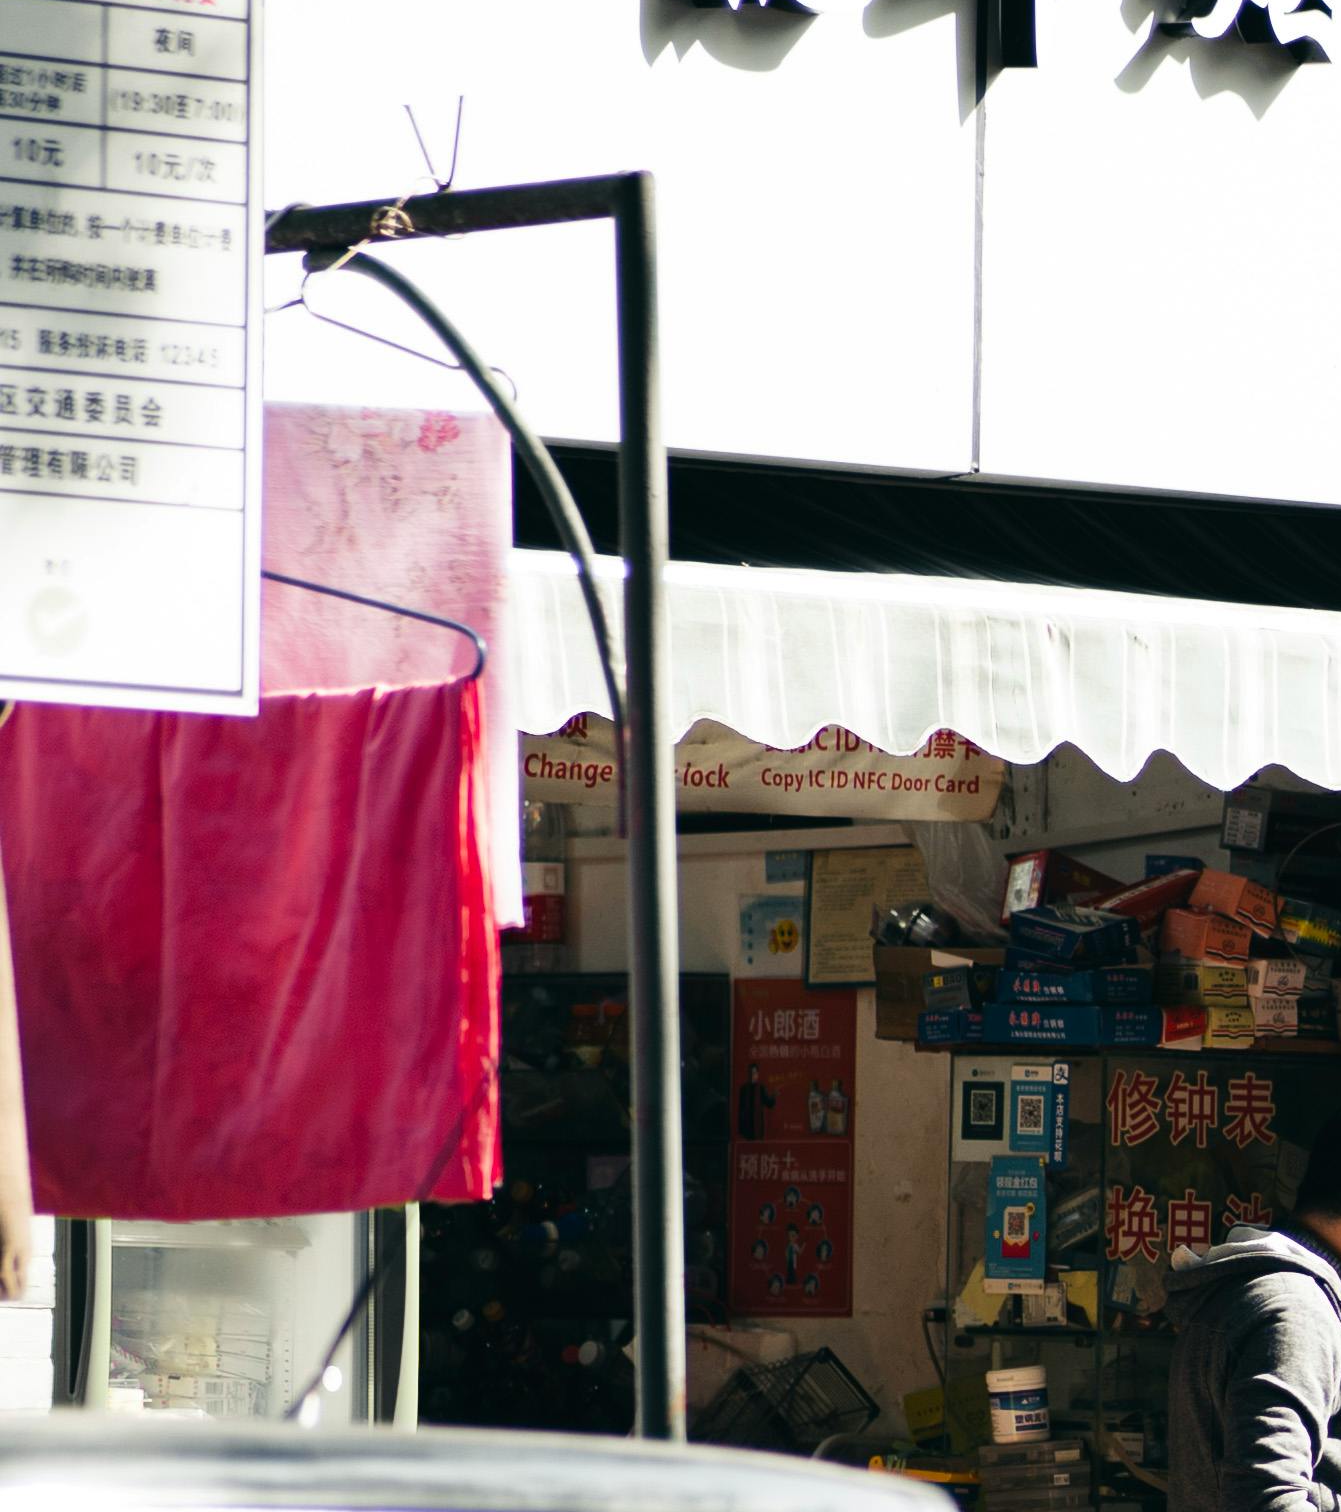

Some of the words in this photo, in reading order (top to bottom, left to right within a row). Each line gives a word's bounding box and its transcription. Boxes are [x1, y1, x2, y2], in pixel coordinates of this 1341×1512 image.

[0, 385, 162, 427] 区交通委员会
[523, 752, 614, 789] Change
[761, 767, 804, 793] Copy
[808, 769, 826, 789] IC
[830, 770, 849, 789] ID
[853, 771, 888, 791] NFC
[891, 773, 931, 793] Door
[934, 774, 980, 795] Card
[748, 1009, 821, 1041] 小郎酒
[1105, 1068, 1278, 1149] 修钟表
